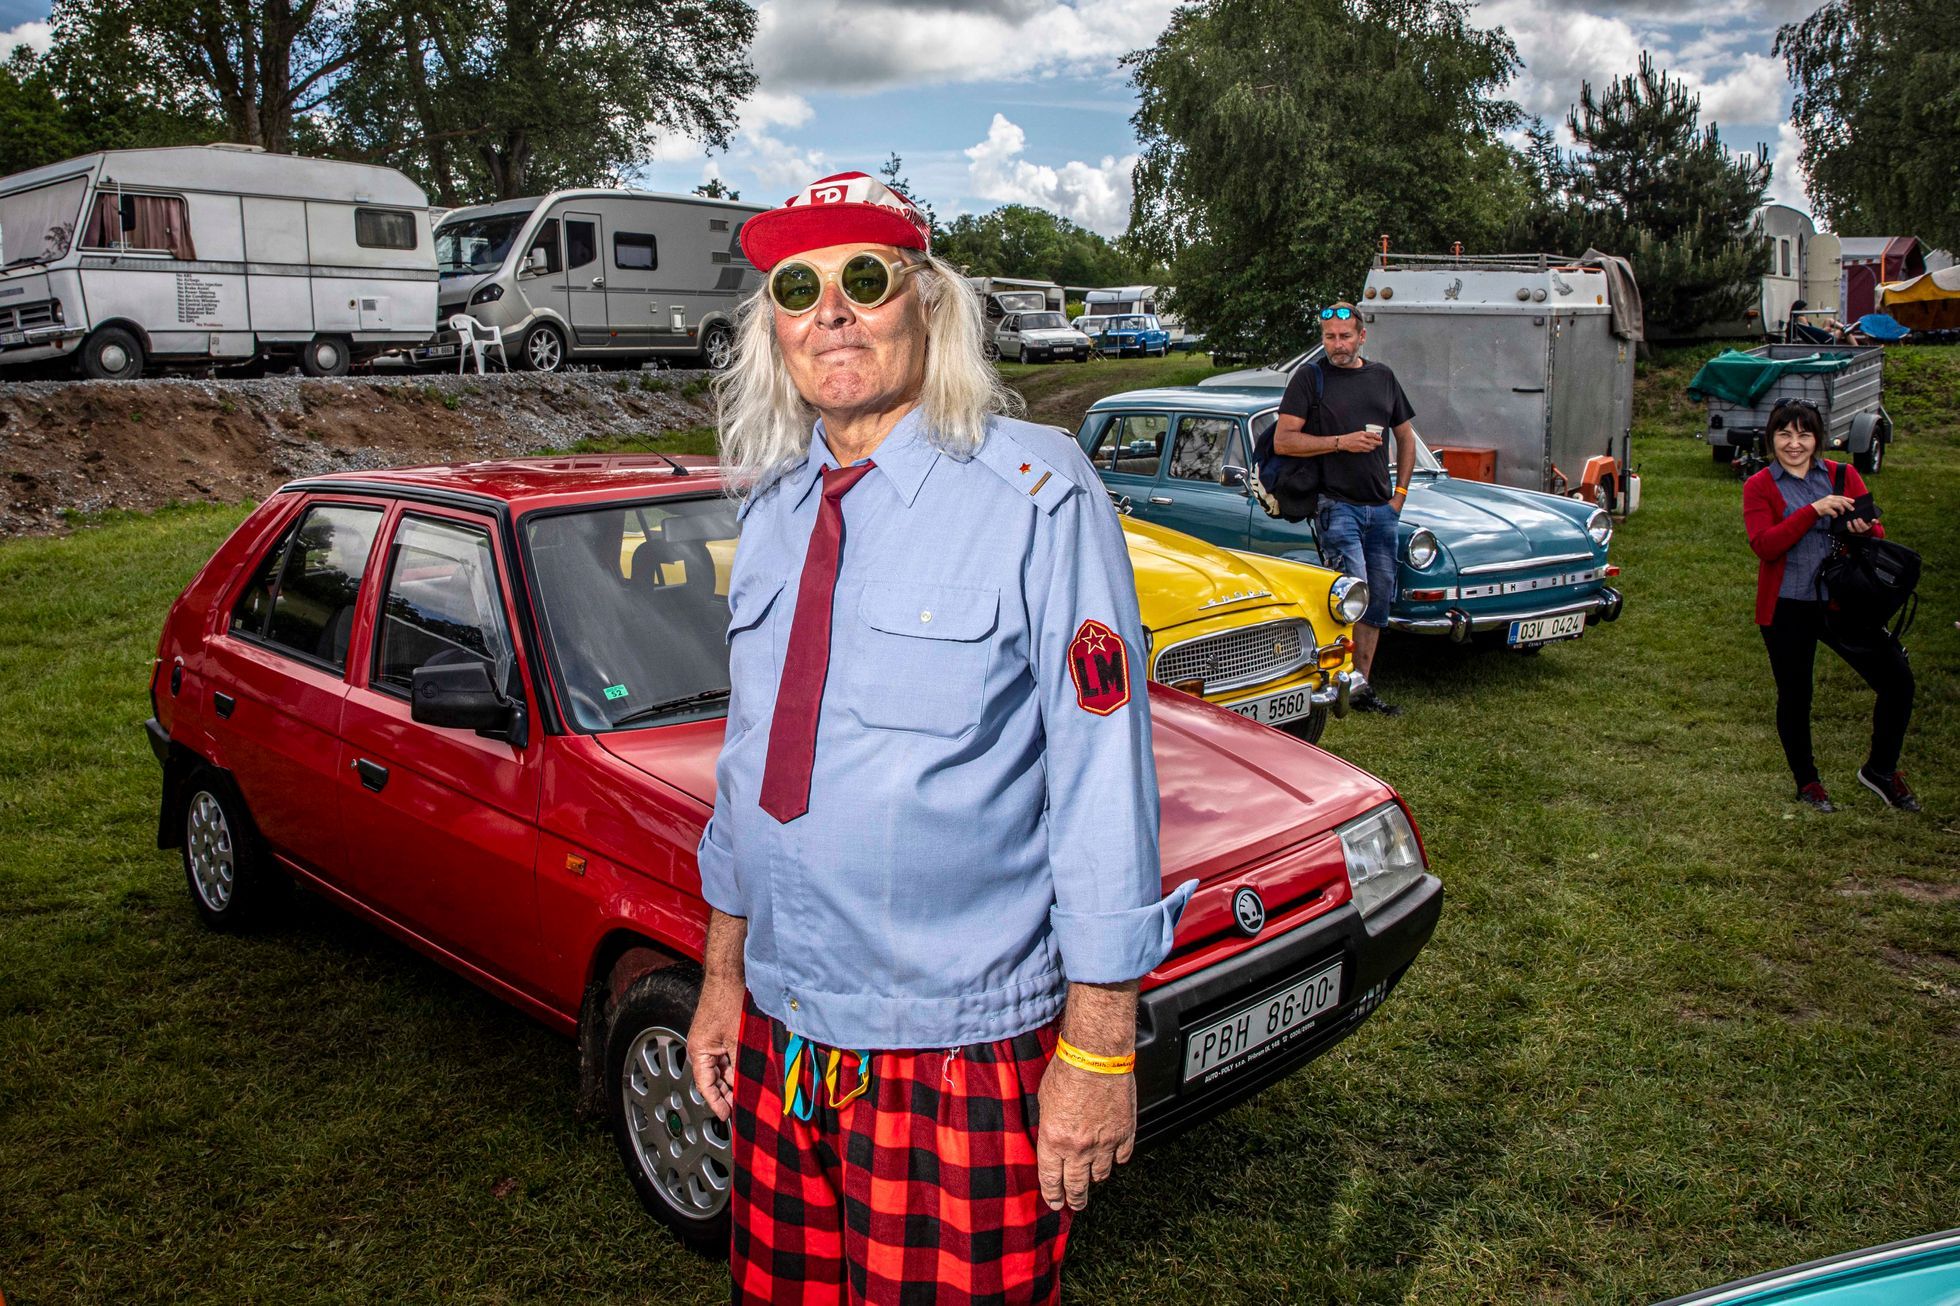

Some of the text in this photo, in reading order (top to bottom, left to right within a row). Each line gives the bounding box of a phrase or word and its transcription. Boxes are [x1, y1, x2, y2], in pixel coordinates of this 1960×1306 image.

[1521, 617, 1579, 640] 03V 0424
[1076, 651, 1124, 699] LM
[1269, 692, 1304, 720] 5560
[1202, 1014, 1251, 1069] PBH
